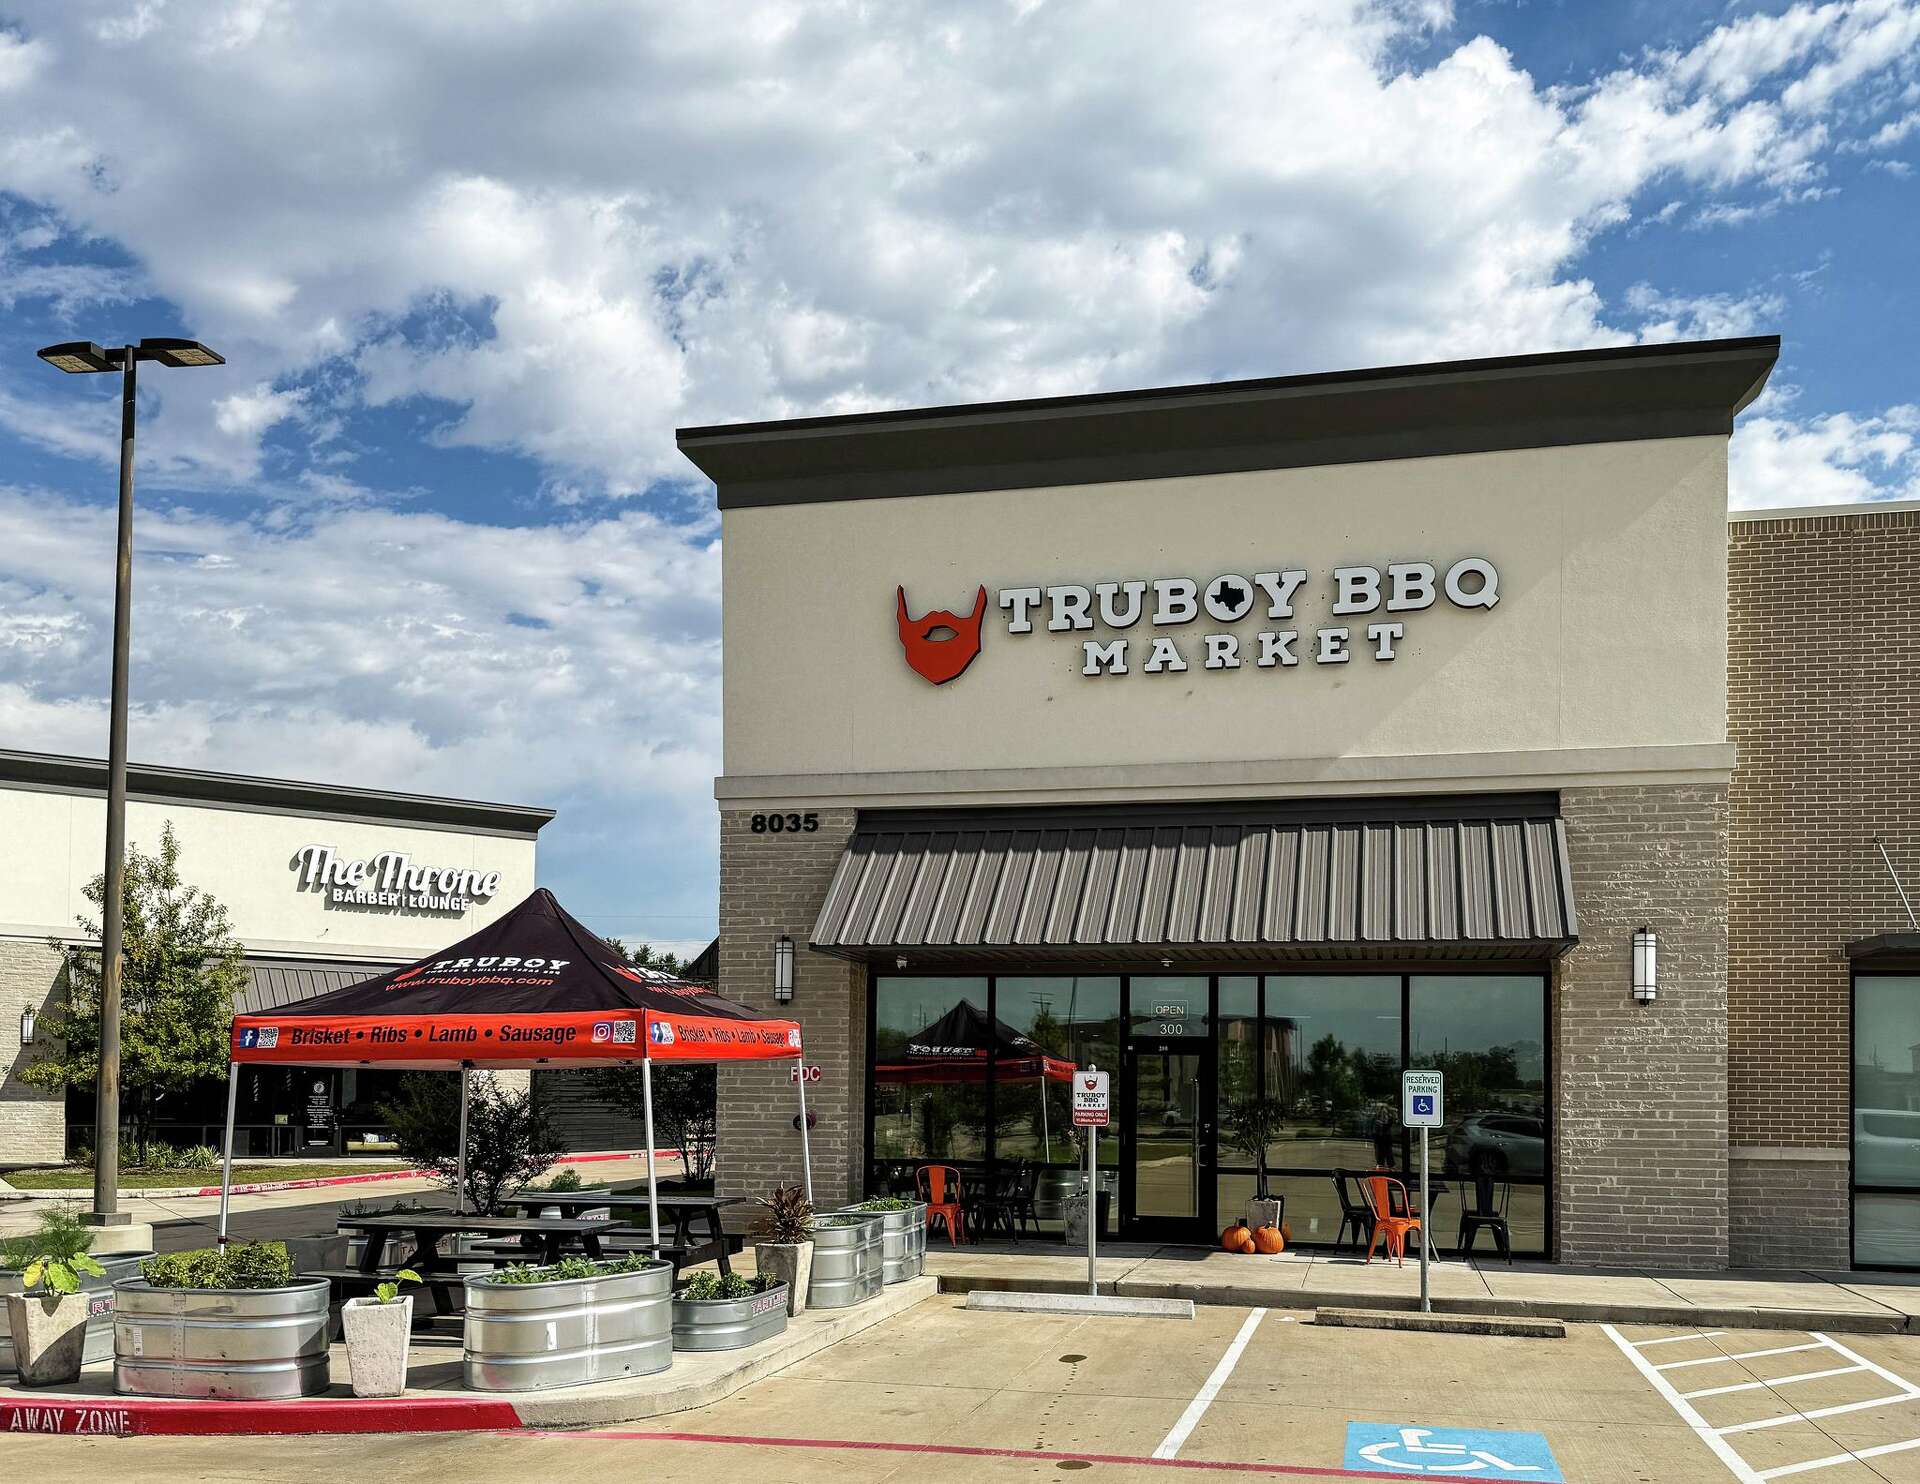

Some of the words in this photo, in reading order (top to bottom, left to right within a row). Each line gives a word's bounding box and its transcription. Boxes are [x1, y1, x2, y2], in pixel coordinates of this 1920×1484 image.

[1000, 570, 1307, 634] TRUBOY
[1332, 557, 1501, 617] BBQ
[1082, 622, 1403, 676] MARKET
[750, 813, 819, 834] 8035
[297, 844, 367, 886] The
[374, 851, 502, 896] Throne
[332, 887, 400, 907] BARBER
[409, 894, 472, 912] LOUNGE
[432, 956, 571, 970] TRUBOY
[385, 975, 554, 992] www.truboybbq.com
[1155, 1005, 1184, 1015] OPEN
[290, 1027, 351, 1044] Brisket
[370, 1026, 408, 1043] Ribs
[429, 1025, 477, 1042] Lamb
[499, 1025, 577, 1045] Sausage
[1160, 1023, 1183, 1035] 300
[790, 1066, 820, 1081] FDC
[1406, 1076, 1440, 1084] RESERVED
[10, 1407, 65, 1433] AWAY
[75, 1409, 131, 1434] ZONE
